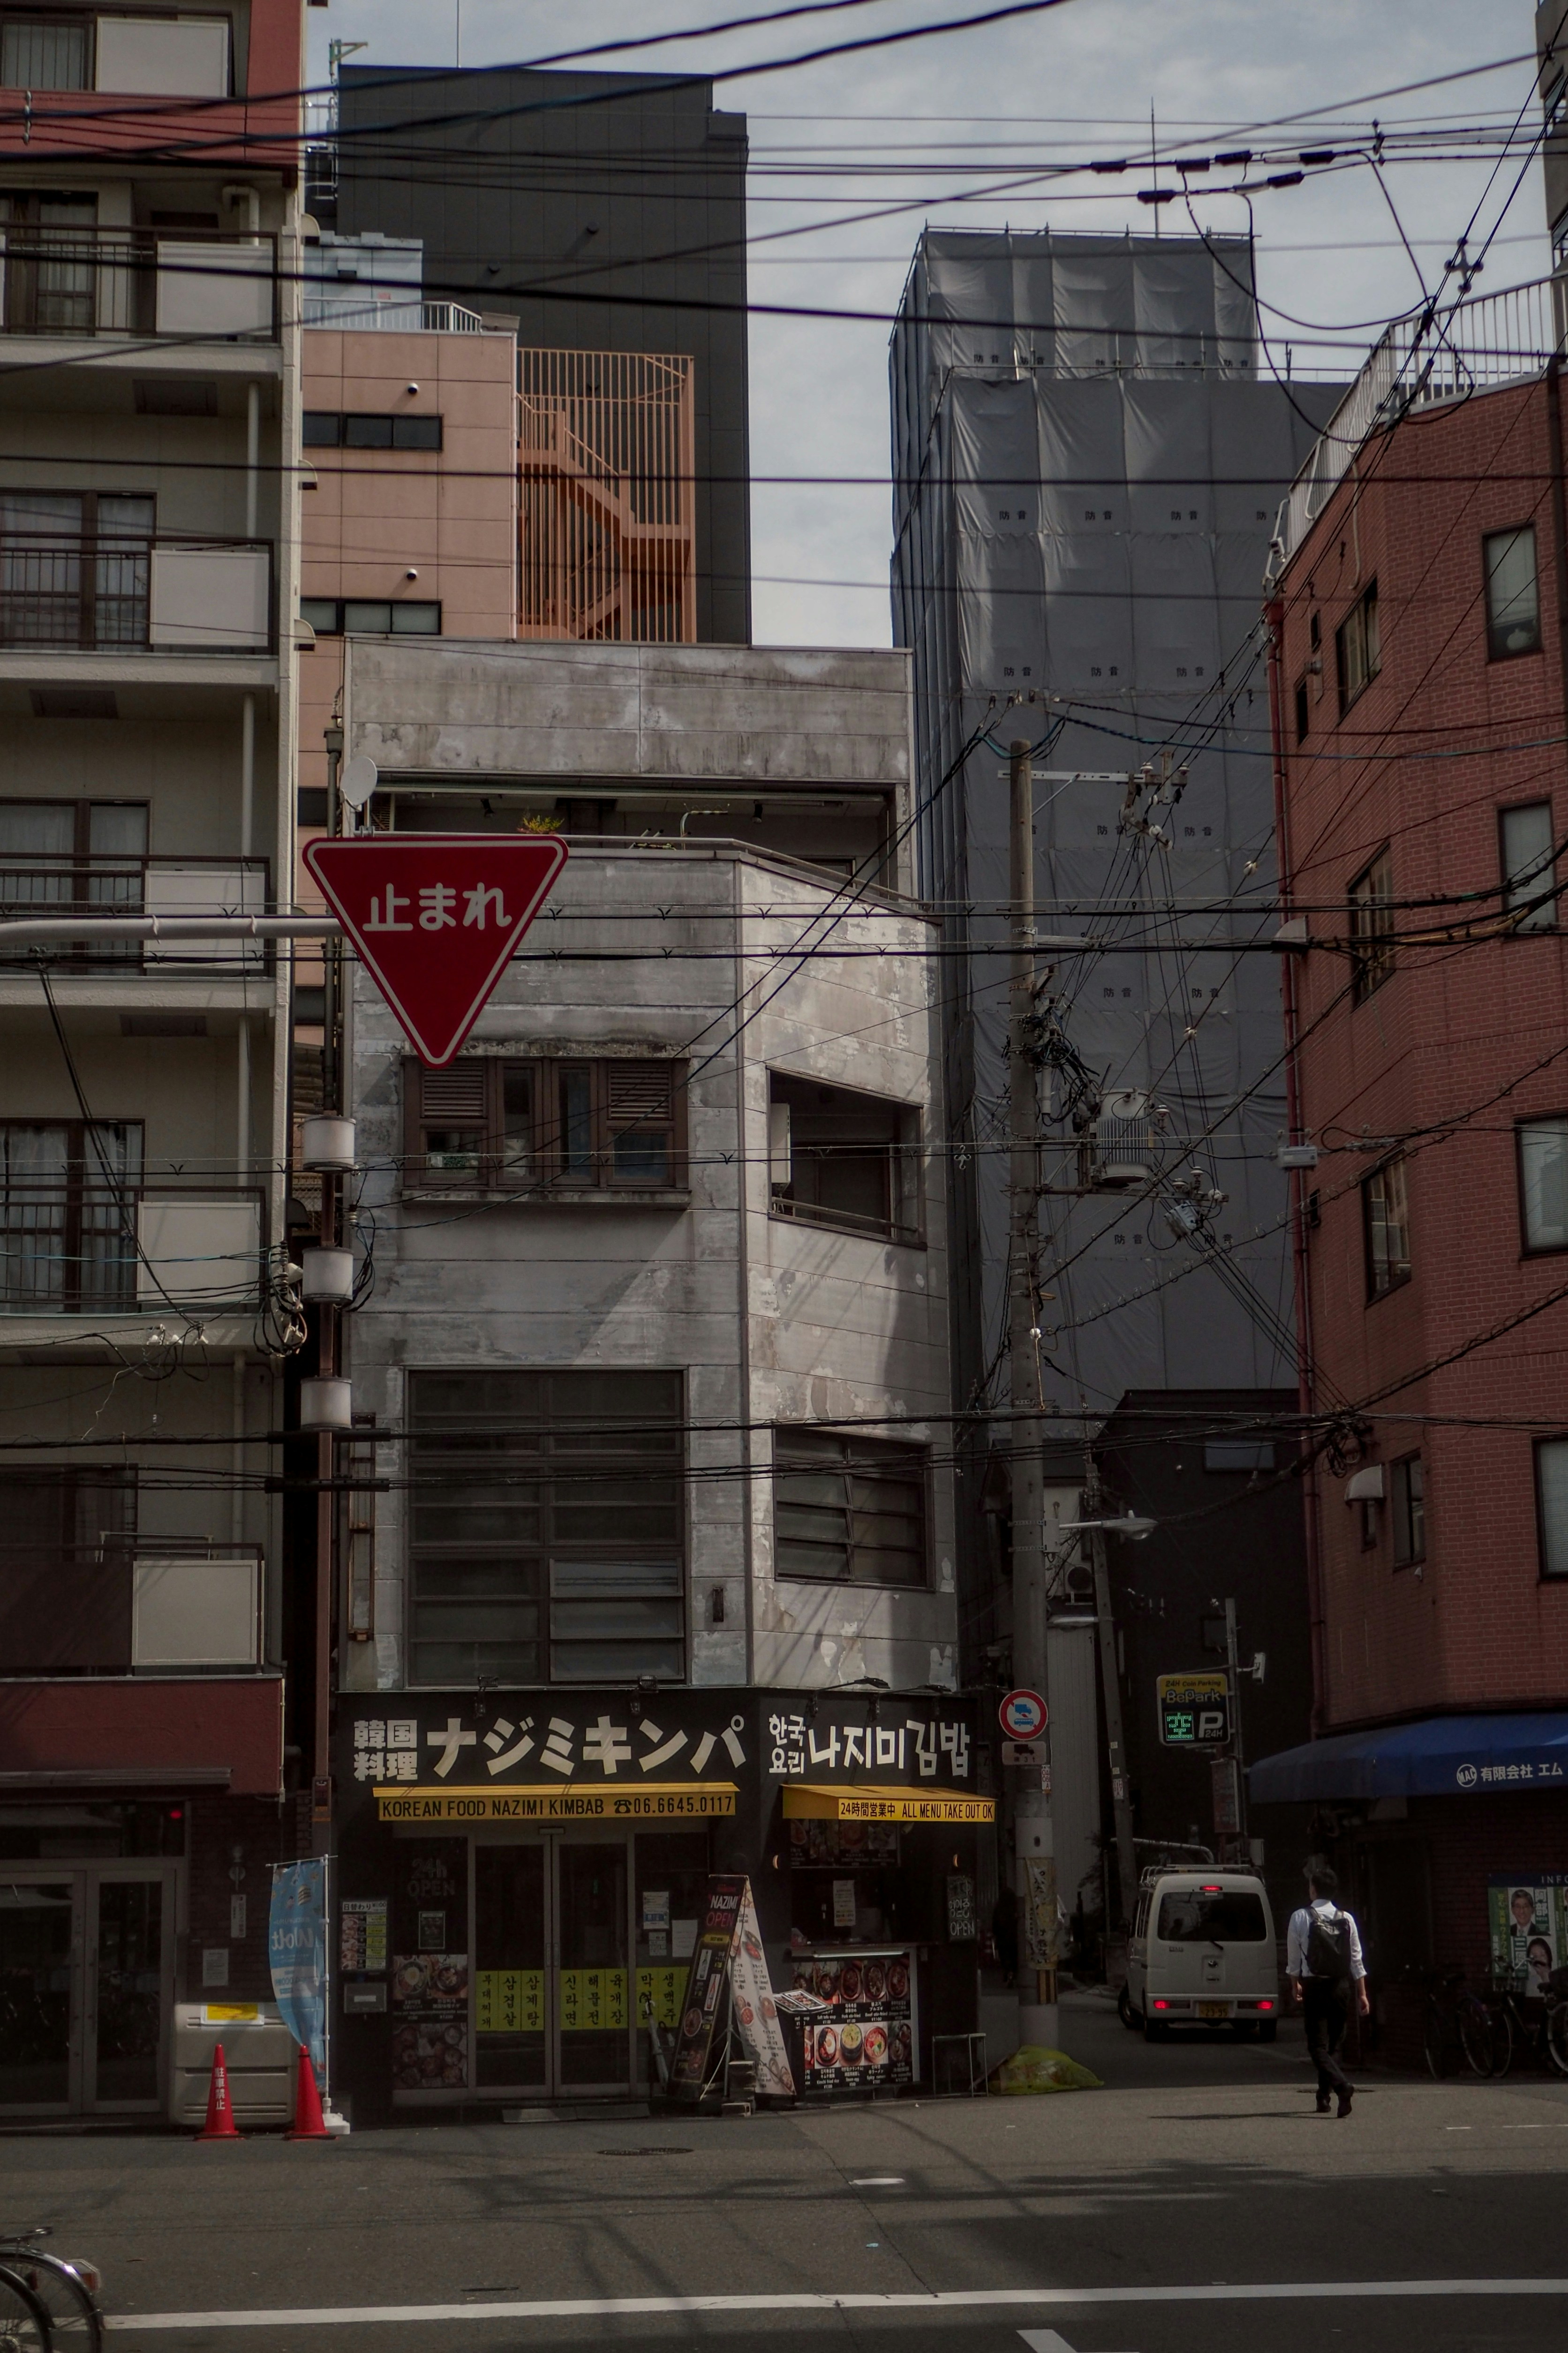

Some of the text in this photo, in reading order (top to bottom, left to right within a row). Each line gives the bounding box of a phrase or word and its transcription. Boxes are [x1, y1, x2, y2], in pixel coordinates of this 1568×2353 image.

[999, 511, 1027, 520] 防音
[1085, 511, 1113, 520] 防音
[1171, 511, 1198, 520] 防音
[1004, 666, 1031, 677] 防音
[1092, 666, 1119, 676] 防音
[1176, 666, 1204, 677] 防音
[1185, 826, 1213, 836] 防音
[362, 882, 513, 932] 止まれ
[1104, 988, 1132, 998] 防音
[1192, 988, 1219, 998] 防音
[1115, 1234, 1143, 1244] 防音
[1166, 1689, 1221, 1703] BePark
[769, 1713, 806, 1746] 한국
[1199, 1712, 1224, 1738] P
[1205, 1729, 1223, 1738] 24H
[354, 1720, 417, 1749] 韓国
[427, 1715, 746, 1778] ナジミキンパ
[354, 1751, 417, 1781] 料理
[769, 1748, 805, 1774] 요리
[1458, 1768, 1476, 1783] MAC
[1480, 1762, 1563, 1782] 有限会社 エム
[383, 1796, 732, 1817] KOREAN FOOD NAZIMI KIMBAB 06.6645.0117
[841, 1802, 993, 1818] 24時間営業中 ALL MENU TAKE OUT OK
[407, 1879, 456, 1897] OPEN
[710, 1895, 738, 1909] NAZIMI
[707, 1911, 735, 1927] OPEN
[950, 1920, 975, 1936] OPEN
[482, 1975, 491, 2028] 부대찌개
[503, 1976, 516, 2026] 삼겹살
[565, 1975, 579, 2025] 신라면
[588, 1975, 600, 2024] 해물전
[610, 1974, 623, 2024] 육개장
[663, 1972, 676, 2022] 생맥주
[215, 2067, 225, 2110] 駐車禁止
